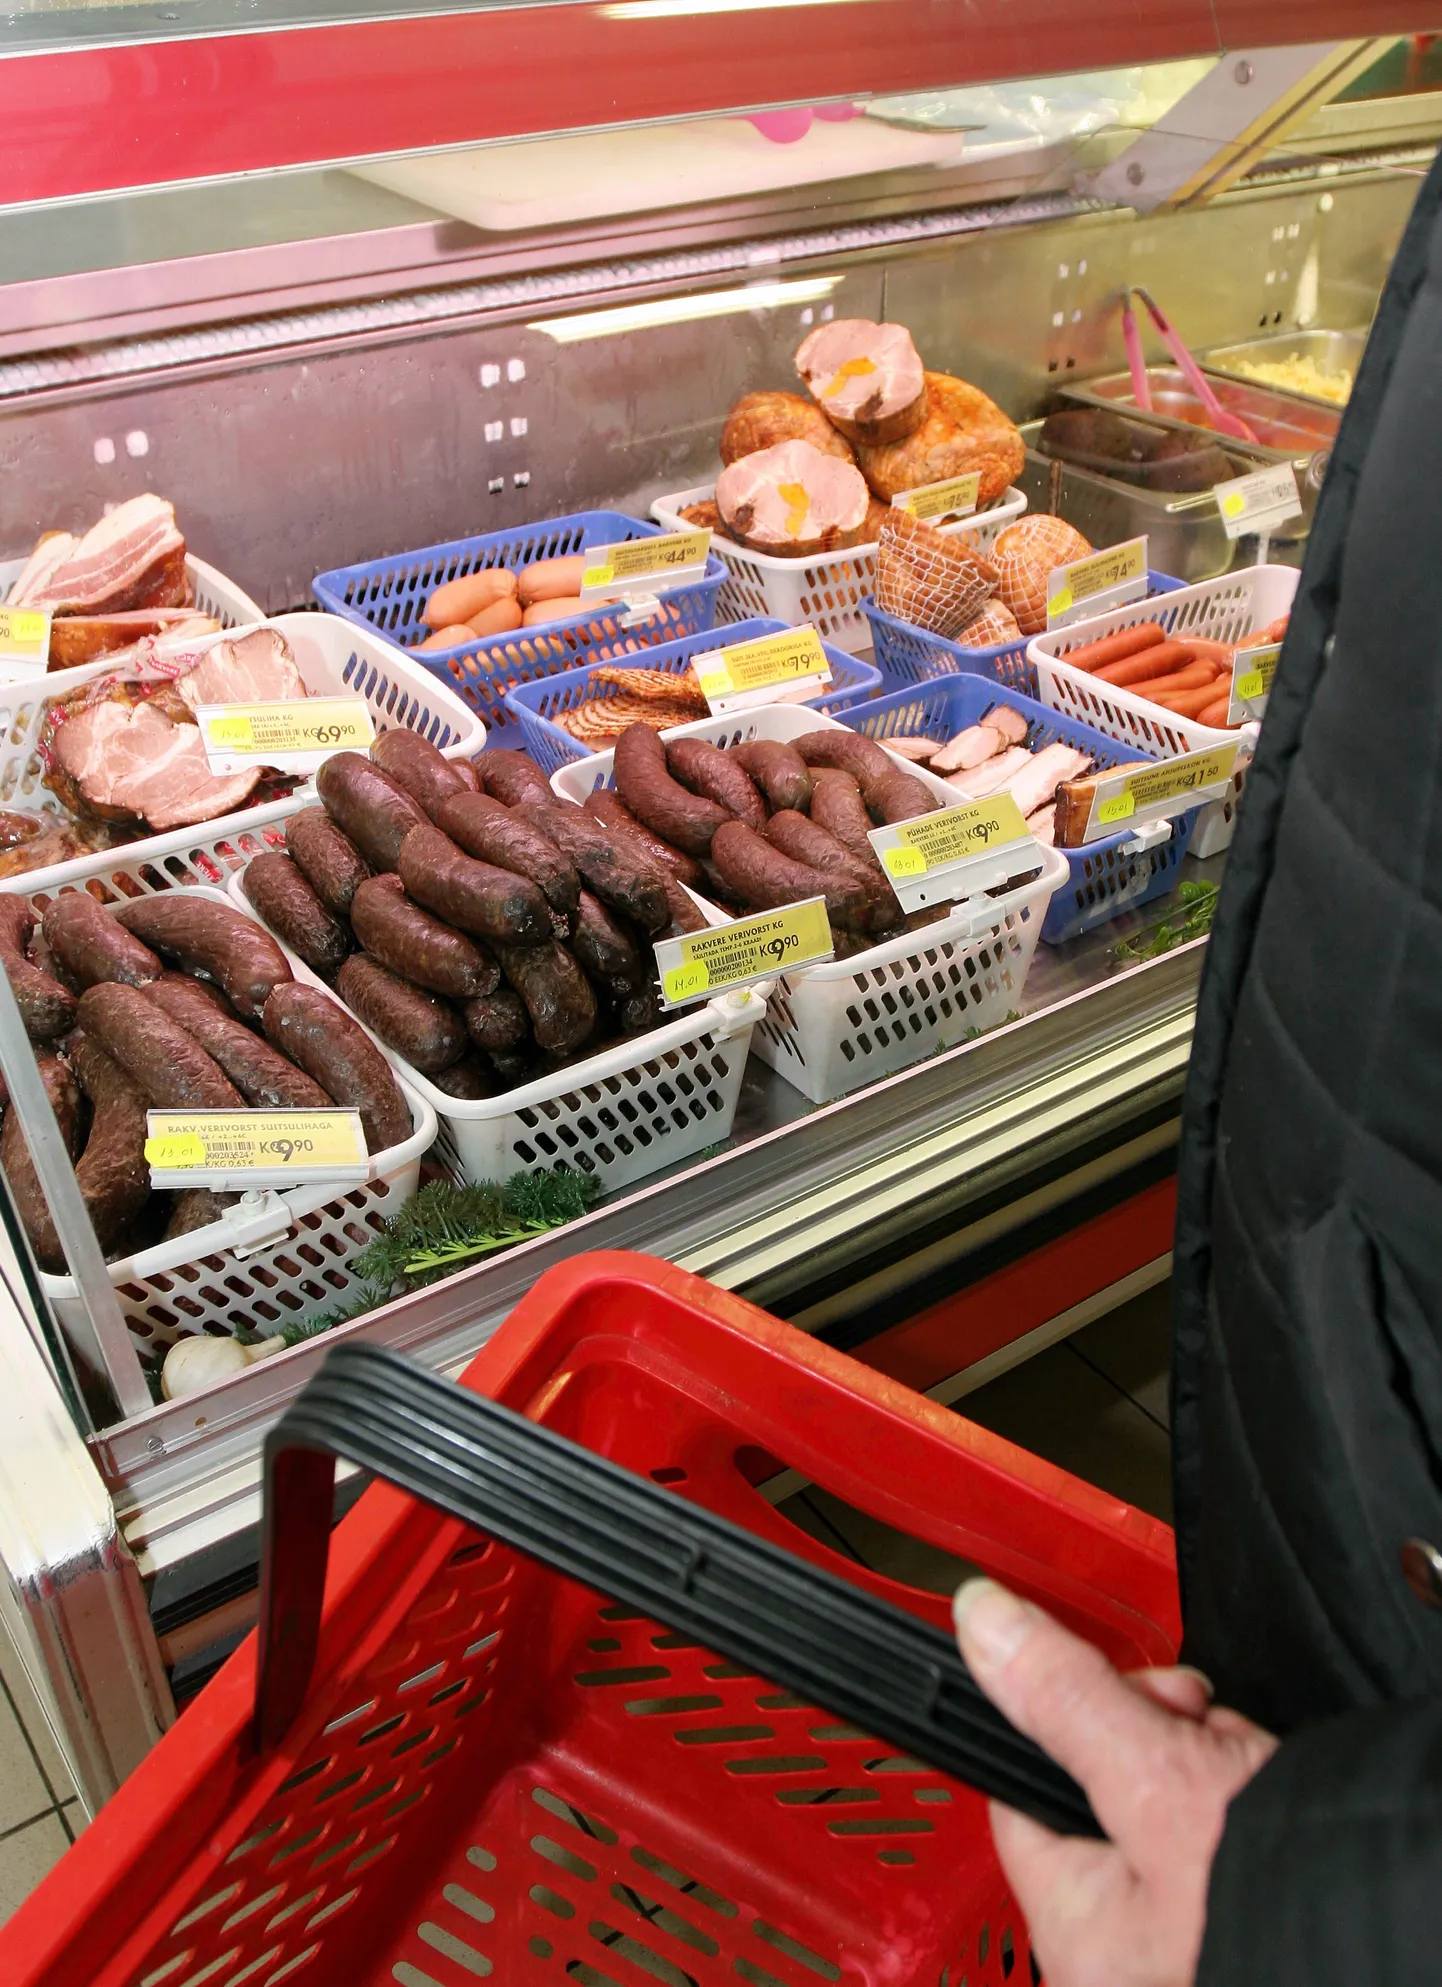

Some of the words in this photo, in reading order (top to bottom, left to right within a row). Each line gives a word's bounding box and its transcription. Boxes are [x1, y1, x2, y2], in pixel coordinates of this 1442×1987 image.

[666, 548, 685, 564] 44
[789, 653, 810, 672] 79
[316, 725, 342, 743] 69
[341, 724, 356, 735] 90
[1207, 765, 1219, 777] 50
[906, 824, 934, 838] PÜHADE
[934, 812, 969, 828] VERIVORST
[969, 809, 980, 818] KG
[691, 936, 727, 953] RAKVERE
[728, 923, 771, 942] VERIVORST
[772, 920, 784, 930] KG
[784, 934, 799, 949] 90
[168, 1124, 257, 1133] RAKV.VERIVORST
[260, 1122, 334, 1131] SUITSULIHAGA
[294, 1139, 314, 1152] 90
[228, 1160, 247, 1169] 0,63
